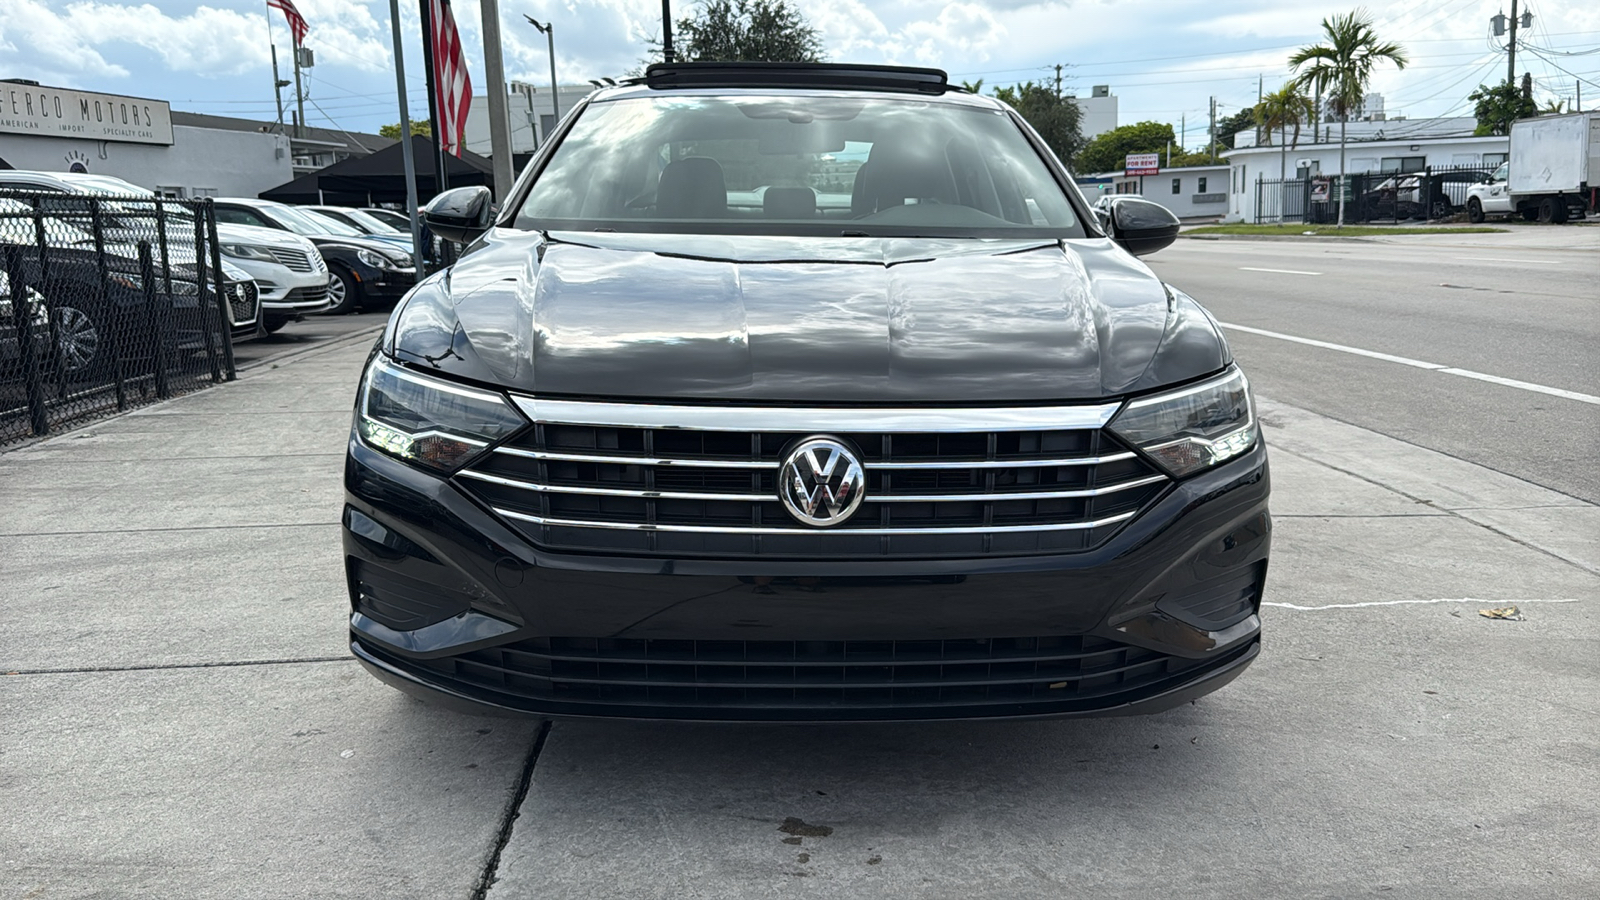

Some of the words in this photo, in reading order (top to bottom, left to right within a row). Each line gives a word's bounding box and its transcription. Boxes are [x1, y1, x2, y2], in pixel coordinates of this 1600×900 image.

[80, 99, 151, 127] MOTORS
[1, 119, 39, 129] AMERICAN
[59, 124, 85, 132] IMPORT
[103, 128, 135, 136] SPECIALTY
[137, 130, 153, 138] CARS
